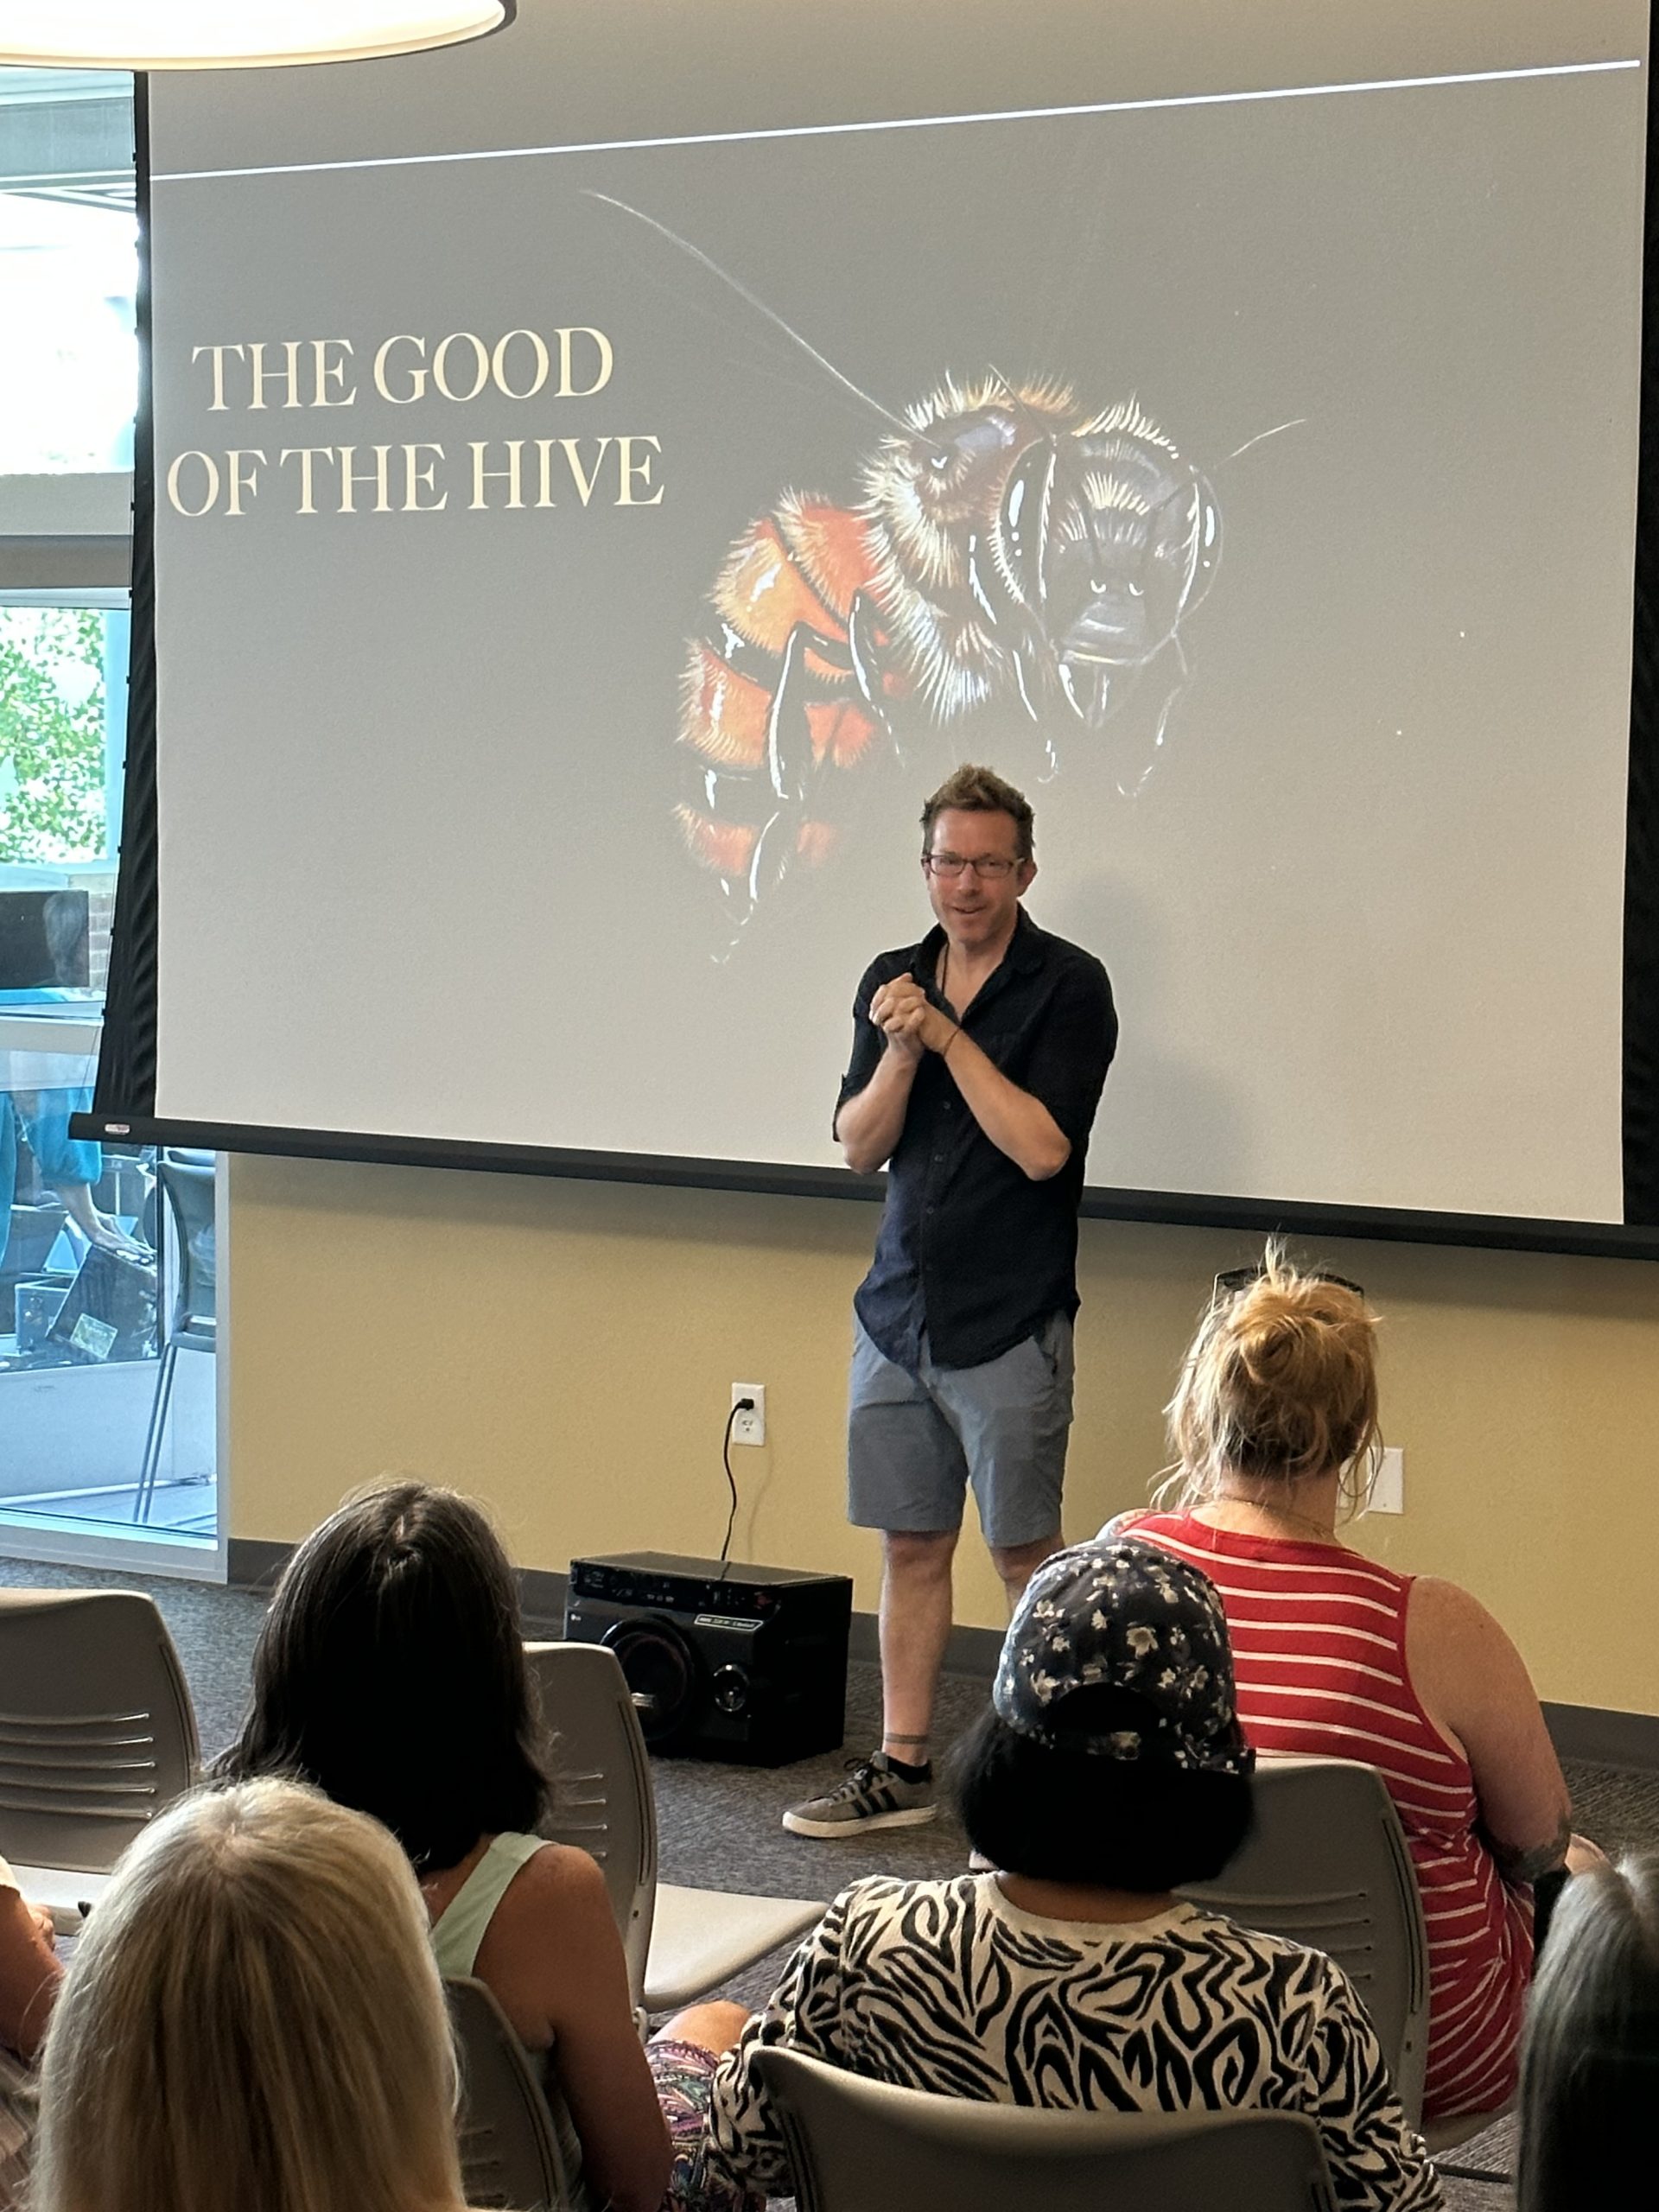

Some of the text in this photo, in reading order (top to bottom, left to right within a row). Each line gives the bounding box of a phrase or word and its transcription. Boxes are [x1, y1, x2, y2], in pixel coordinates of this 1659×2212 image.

[192, 327, 613, 411] THE GOOD
[167, 435, 665, 517] OF THE HIVE
